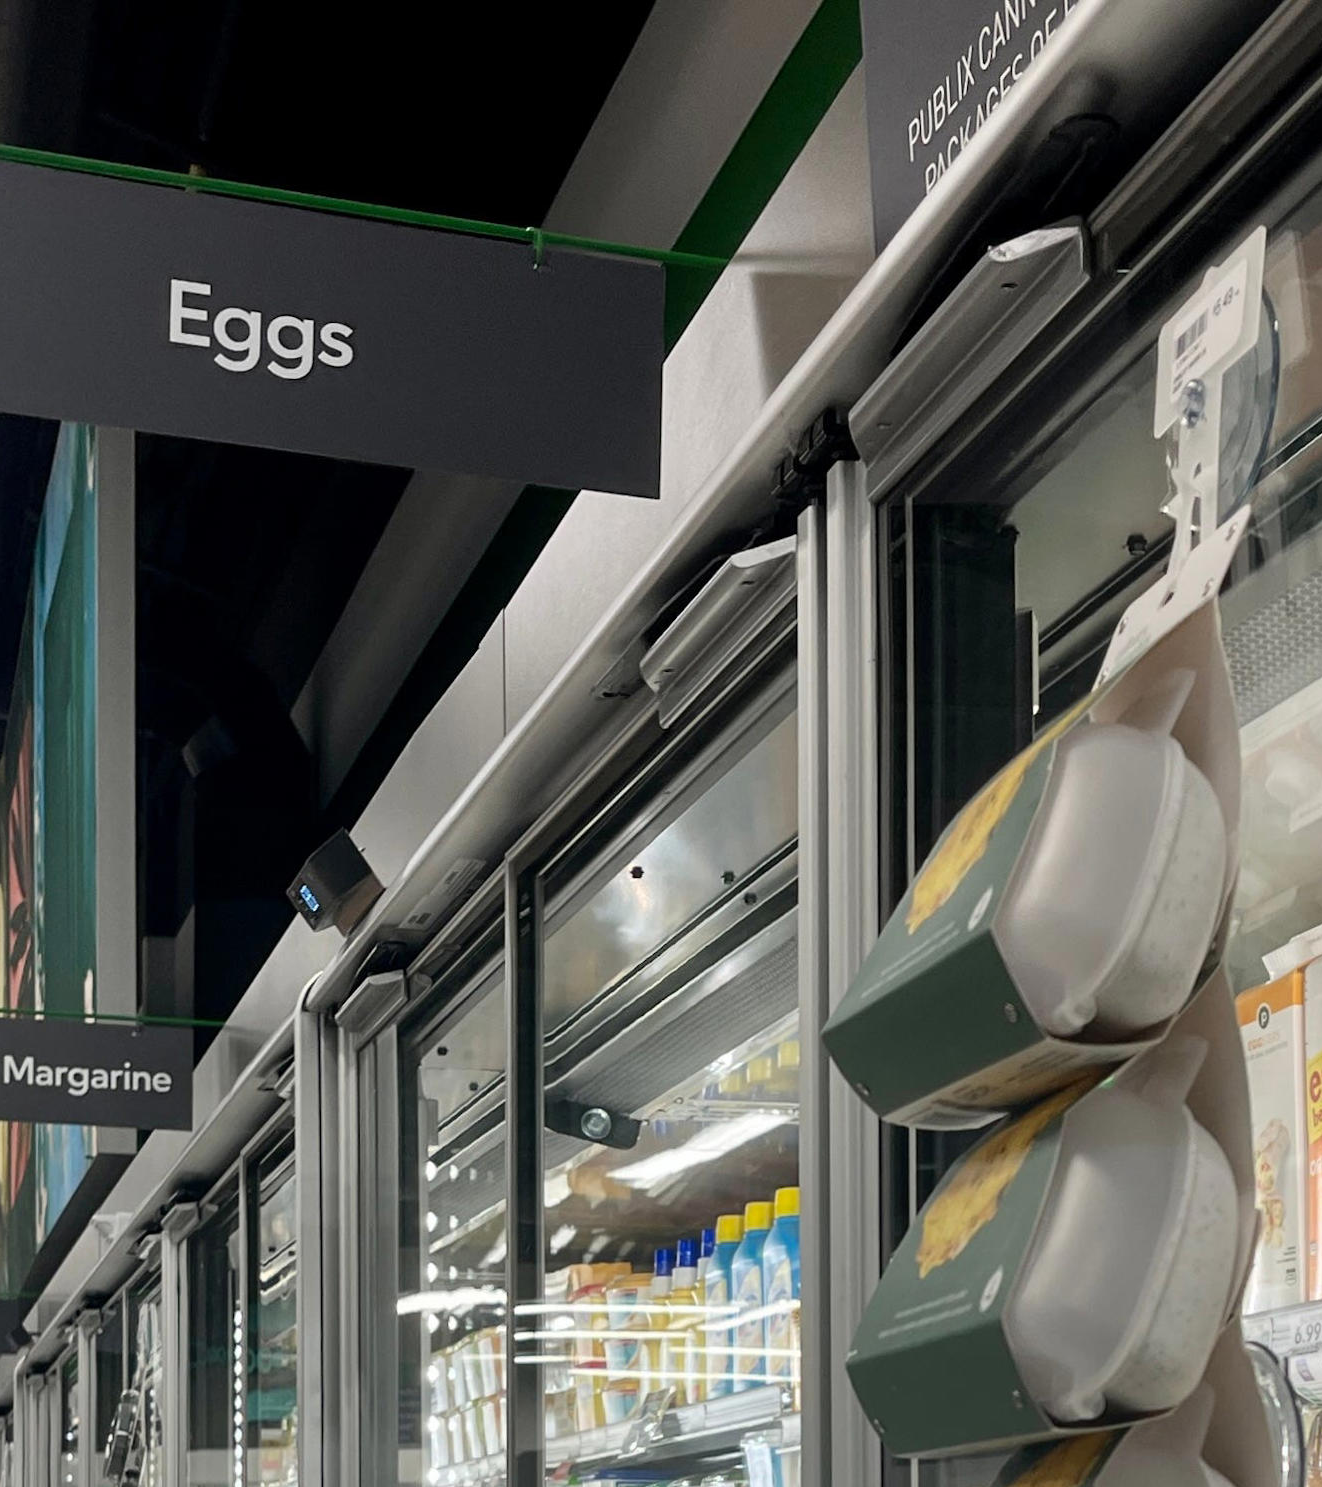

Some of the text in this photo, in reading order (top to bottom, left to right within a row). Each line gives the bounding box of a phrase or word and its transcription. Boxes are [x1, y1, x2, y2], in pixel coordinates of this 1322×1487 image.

[907, 45, 975, 162] PUBLIX
[167, 278, 356, 381] Eggs
[3, 1055, 172, 1096] Margarine
[1294, 1322, 1322, 1344] 6.99
